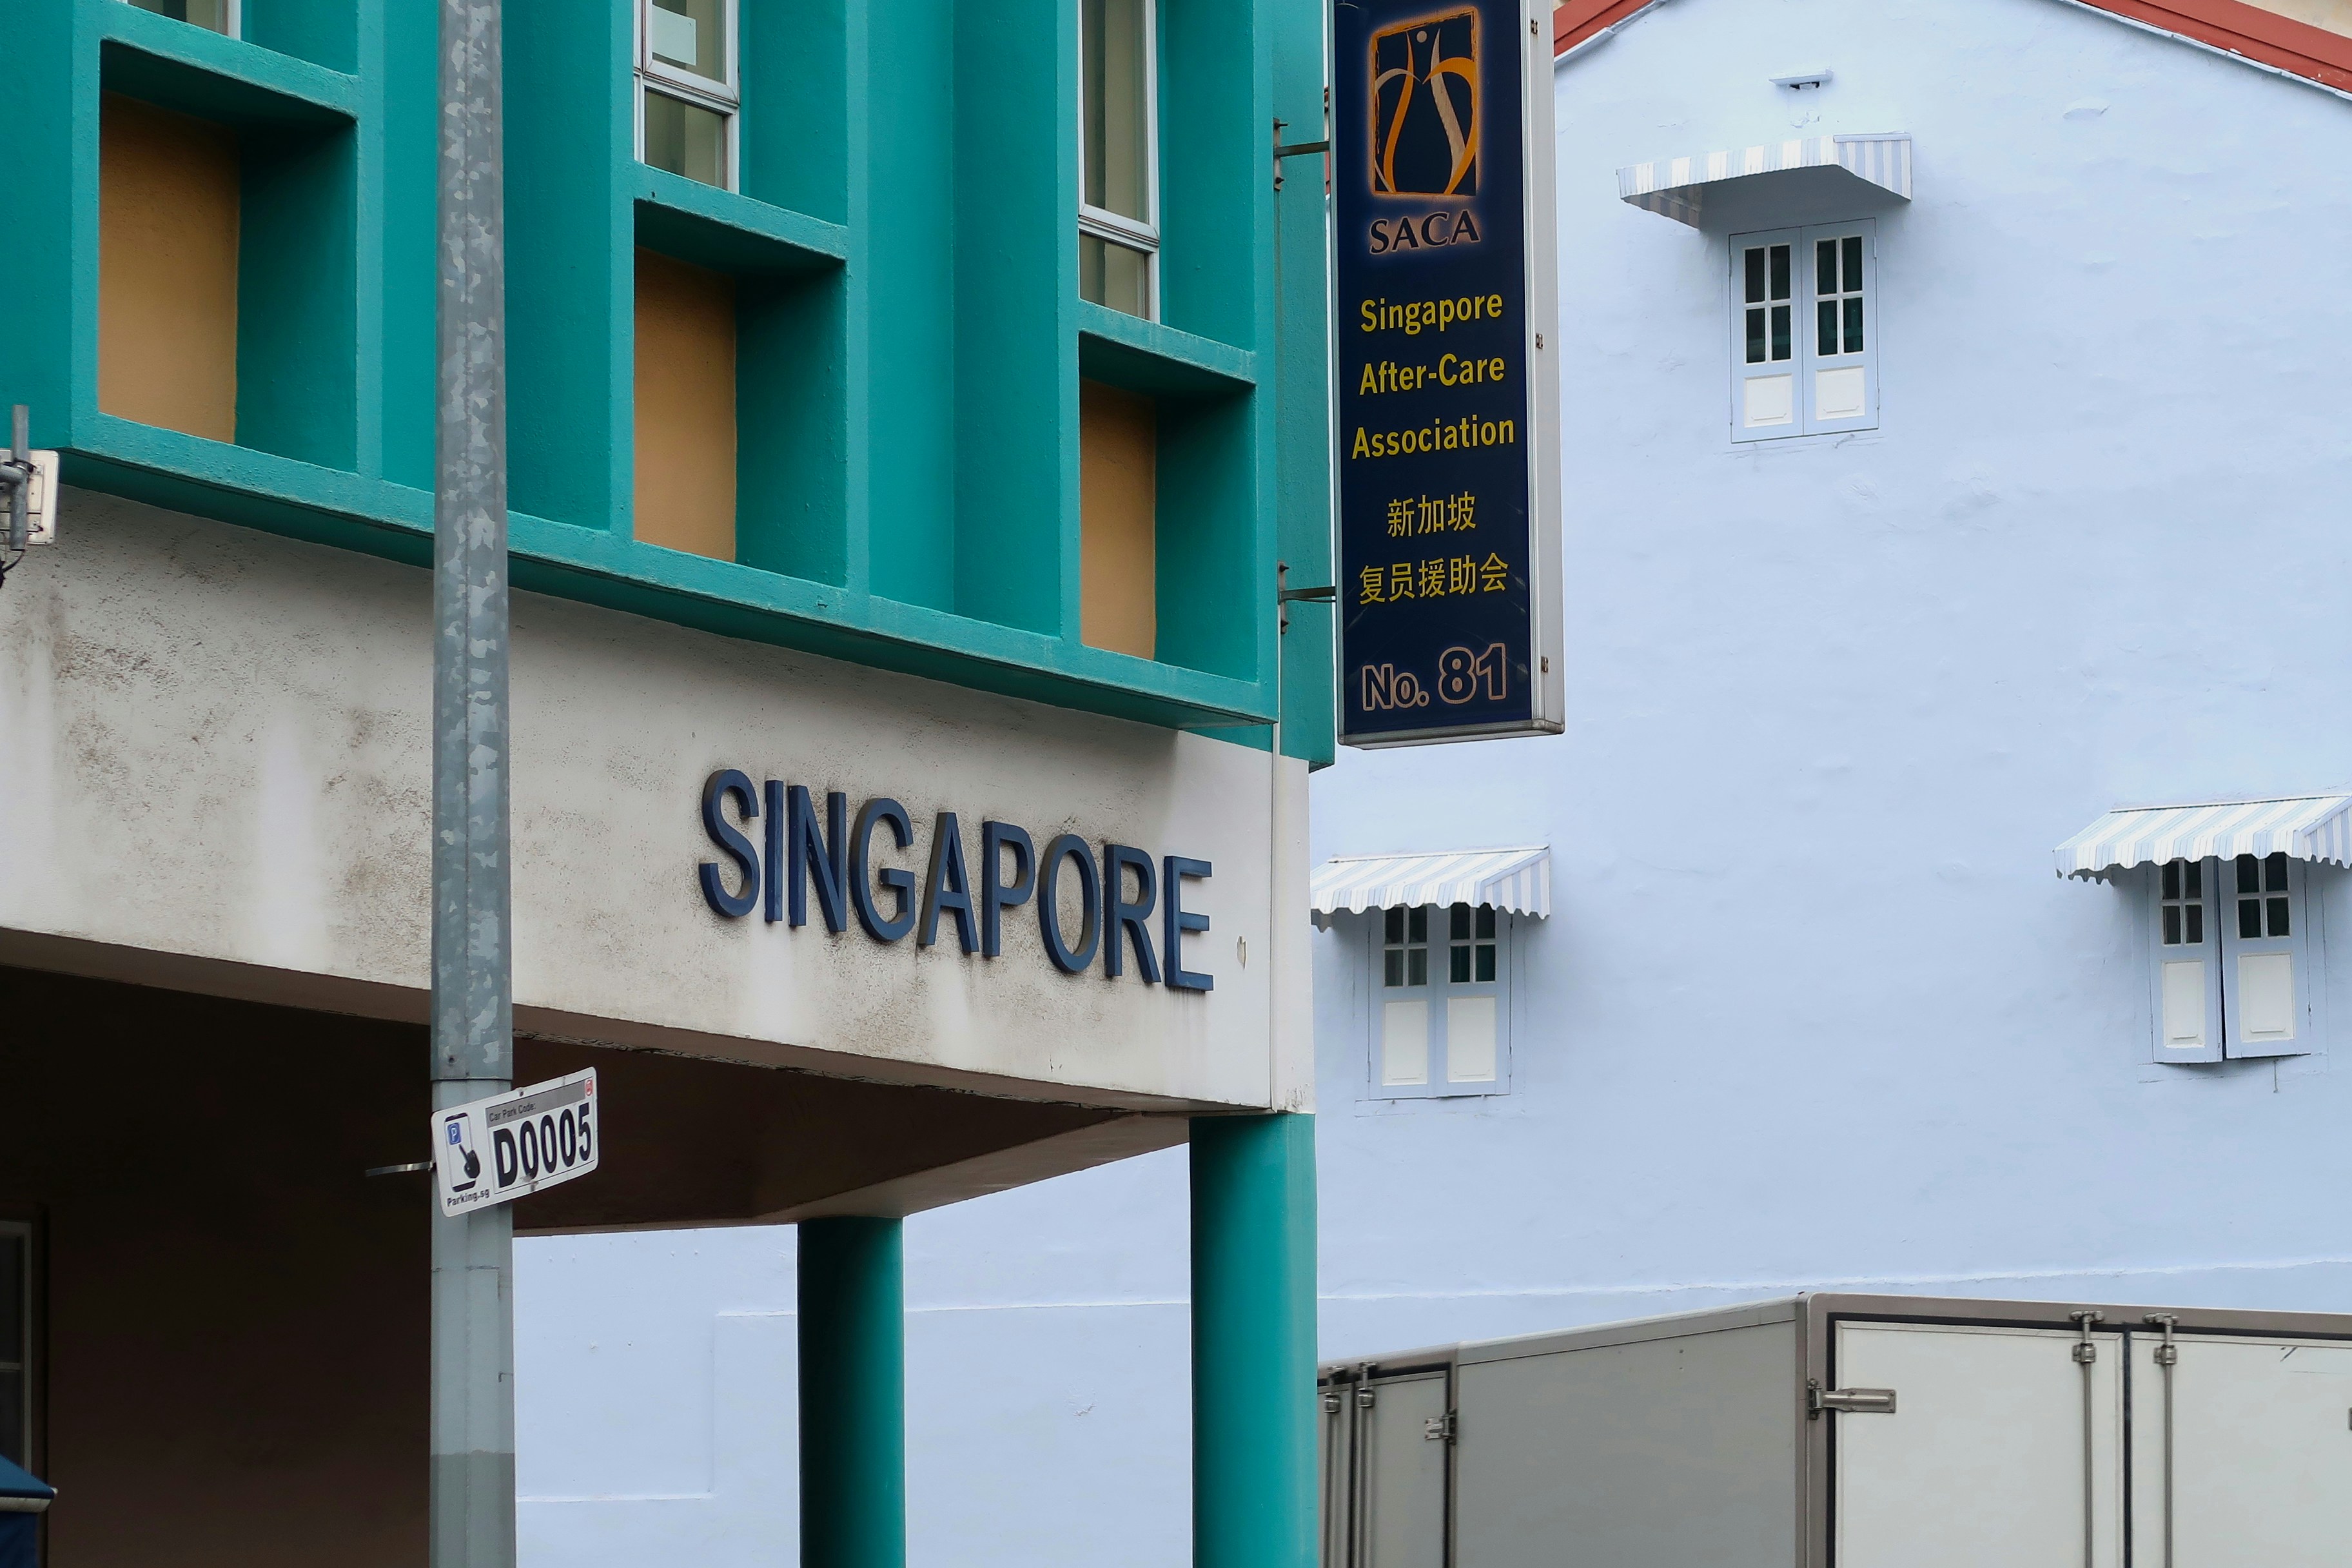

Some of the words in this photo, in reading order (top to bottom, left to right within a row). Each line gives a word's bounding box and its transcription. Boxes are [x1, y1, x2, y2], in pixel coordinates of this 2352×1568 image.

[1369, 210, 1480, 254] SACA
[1361, 294, 1502, 335] Singapore
[1359, 353, 1505, 395] After-Care
[1352, 414, 1514, 459] Association
[1387, 491, 1476, 538] 新加坡
[1359, 553, 1509, 605] 复员援助会
[1362, 663, 1430, 711] No.
[1438, 643, 1507, 705] 81
[699, 769, 1214, 992] SINGAPORE
[489, 1111, 501, 1122] Car
[502, 1106, 516, 1117] Park
[518, 1102, 536, 1113] Code:
[493, 1102, 592, 1188] D0005
[447, 1189, 490, 1207] Parking.sg
